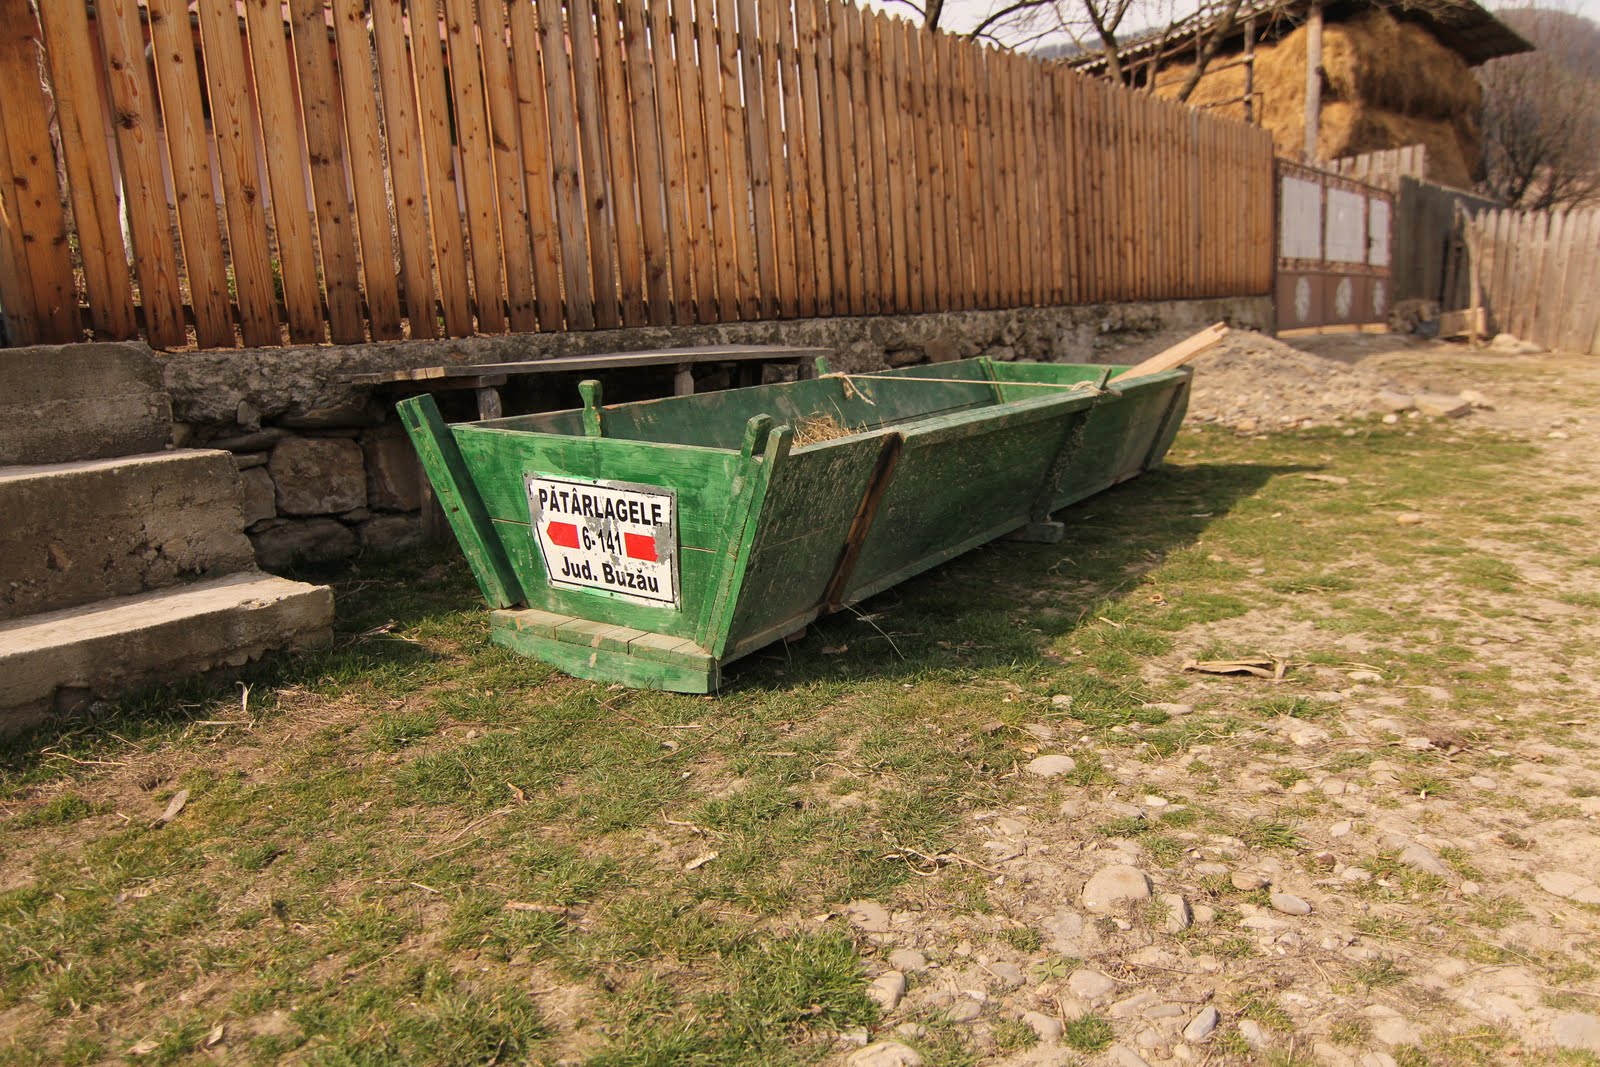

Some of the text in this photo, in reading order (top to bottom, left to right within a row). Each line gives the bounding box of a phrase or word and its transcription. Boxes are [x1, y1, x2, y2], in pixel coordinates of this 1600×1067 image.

[538, 485, 663, 527] PĂTÂRLAGELE
[582, 526, 623, 556] 6-141
[561, 556, 659, 593] Jud. Buzău
